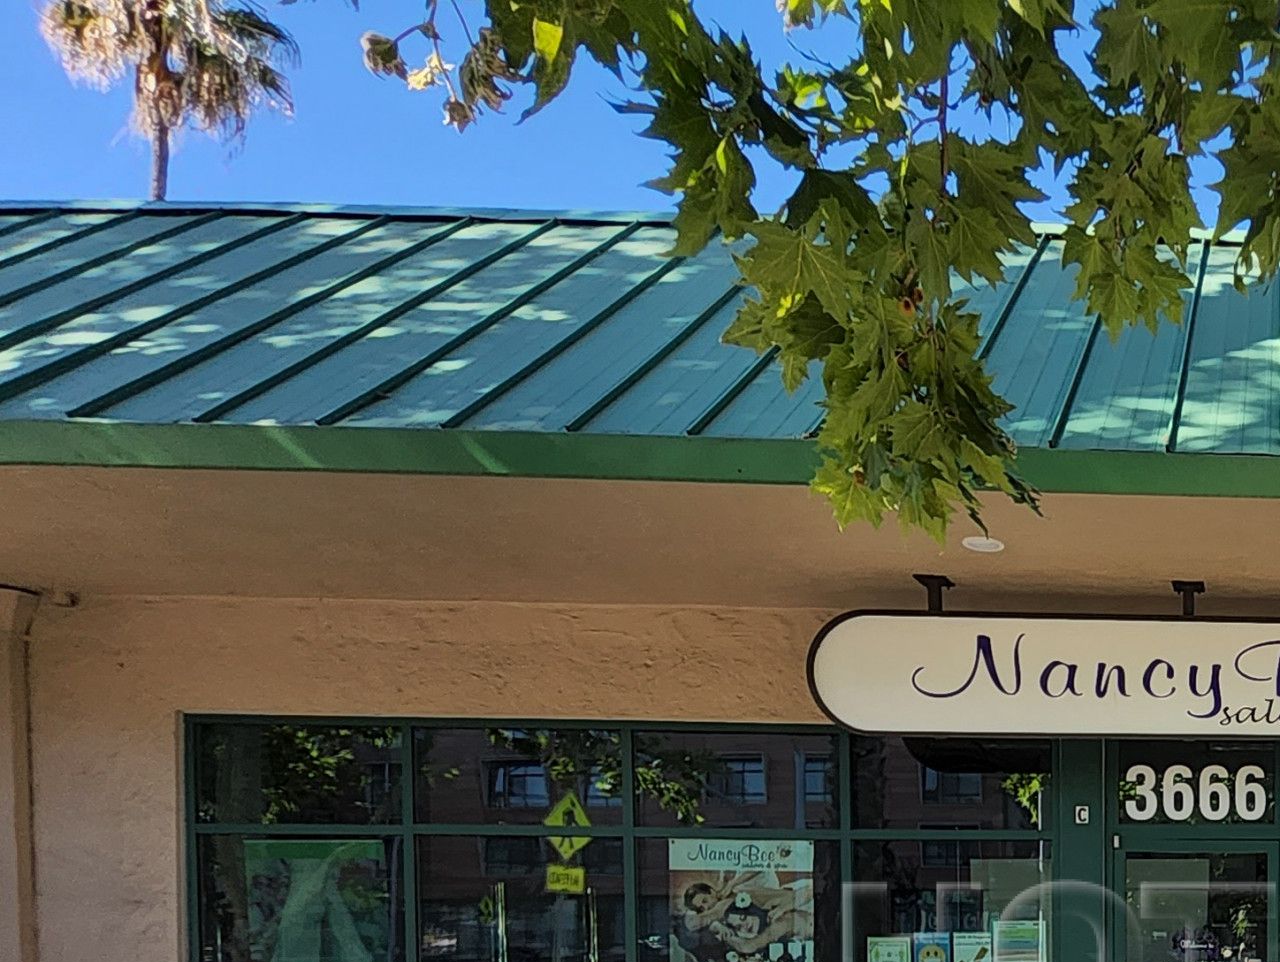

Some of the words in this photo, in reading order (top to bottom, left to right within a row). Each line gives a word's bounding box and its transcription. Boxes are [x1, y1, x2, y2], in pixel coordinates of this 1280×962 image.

[912, 633, 1222, 719] Nancy
[1124, 764, 1267, 822] 3666
[1077, 807, 1087, 822] C
[687, 843, 741, 866] Nancy
[740, 843, 775, 862] Bee
